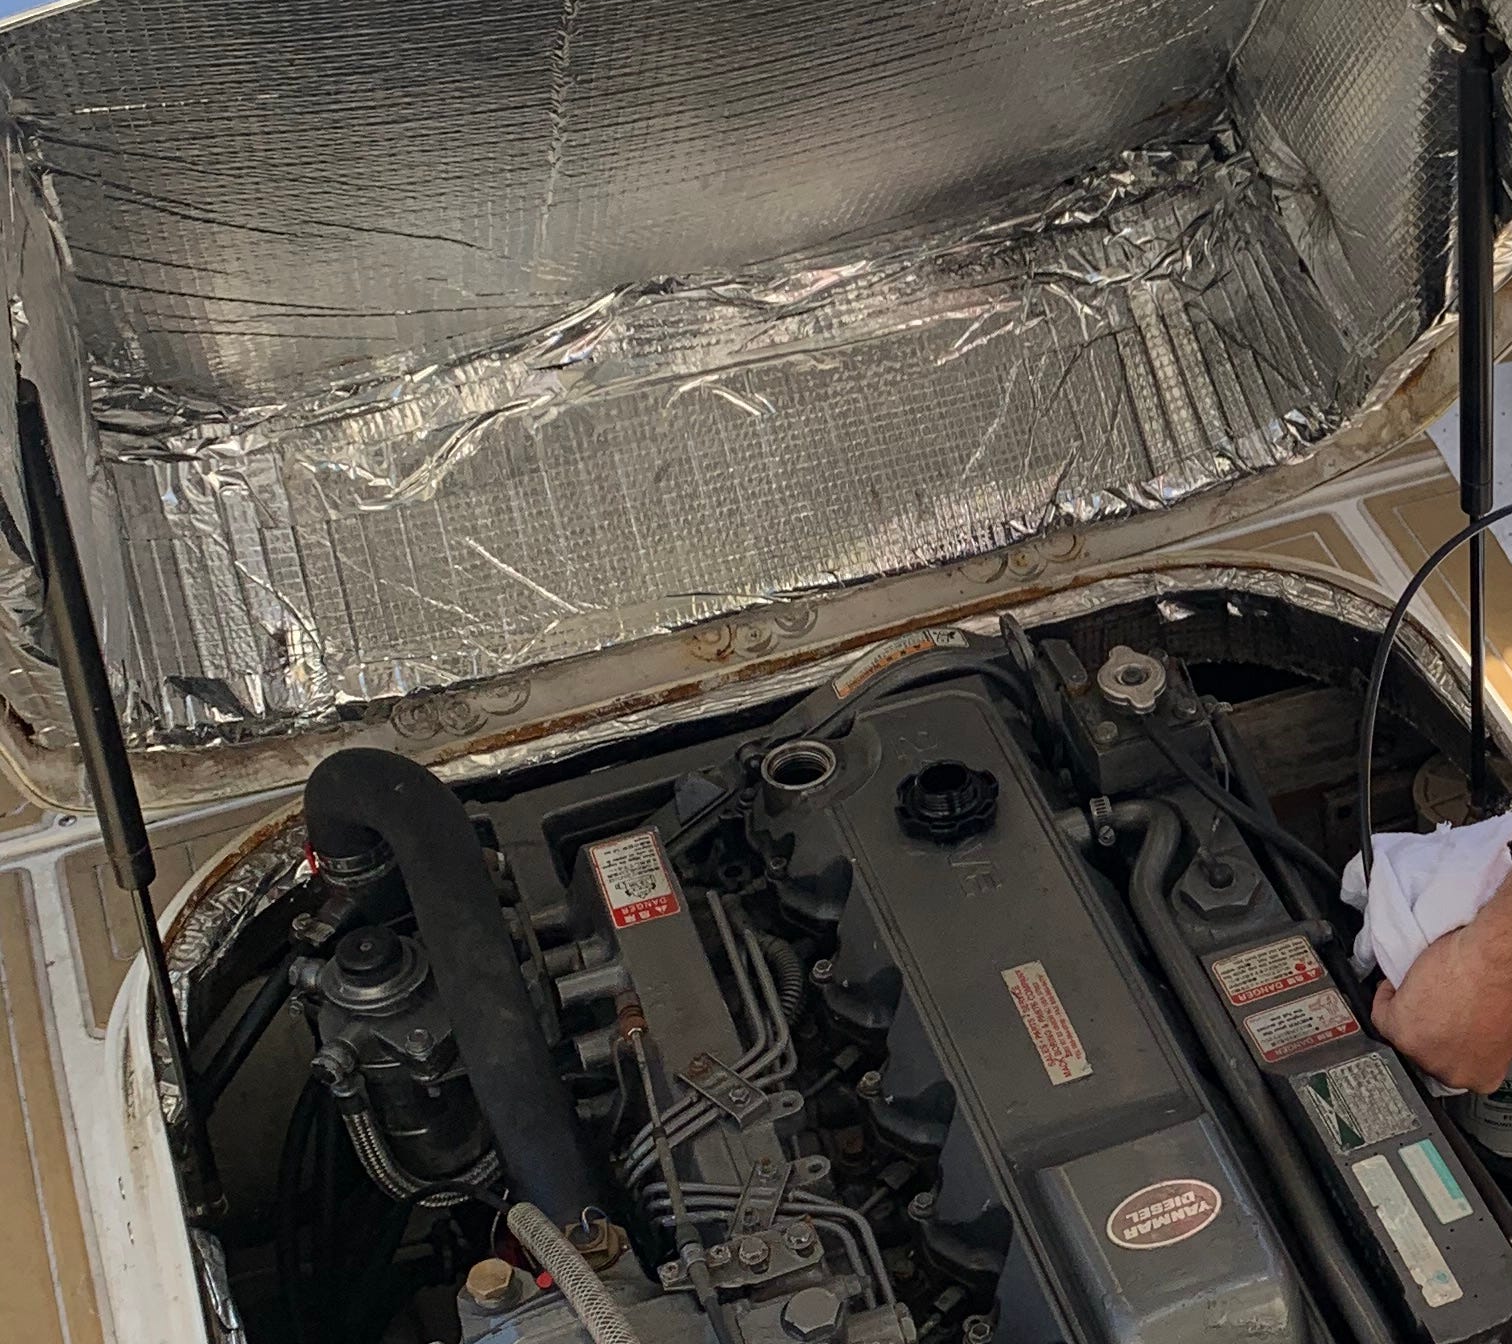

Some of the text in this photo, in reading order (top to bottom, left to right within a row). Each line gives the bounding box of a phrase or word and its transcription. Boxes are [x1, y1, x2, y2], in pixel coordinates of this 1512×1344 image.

[621, 897, 667, 914] DANGER
[1237, 982, 1284, 1002] DANGER
[1027, 1017, 1042, 1040] PARTS
[1044, 1029, 1063, 1057] BORING
[1274, 1037, 1315, 1056] DANGER
[1040, 1044, 1057, 1067] SALES
[1054, 1056, 1072, 1078] MACK
[1125, 1191, 1196, 1223] DIESEL
[1122, 1199, 1213, 1240] YANMAR
